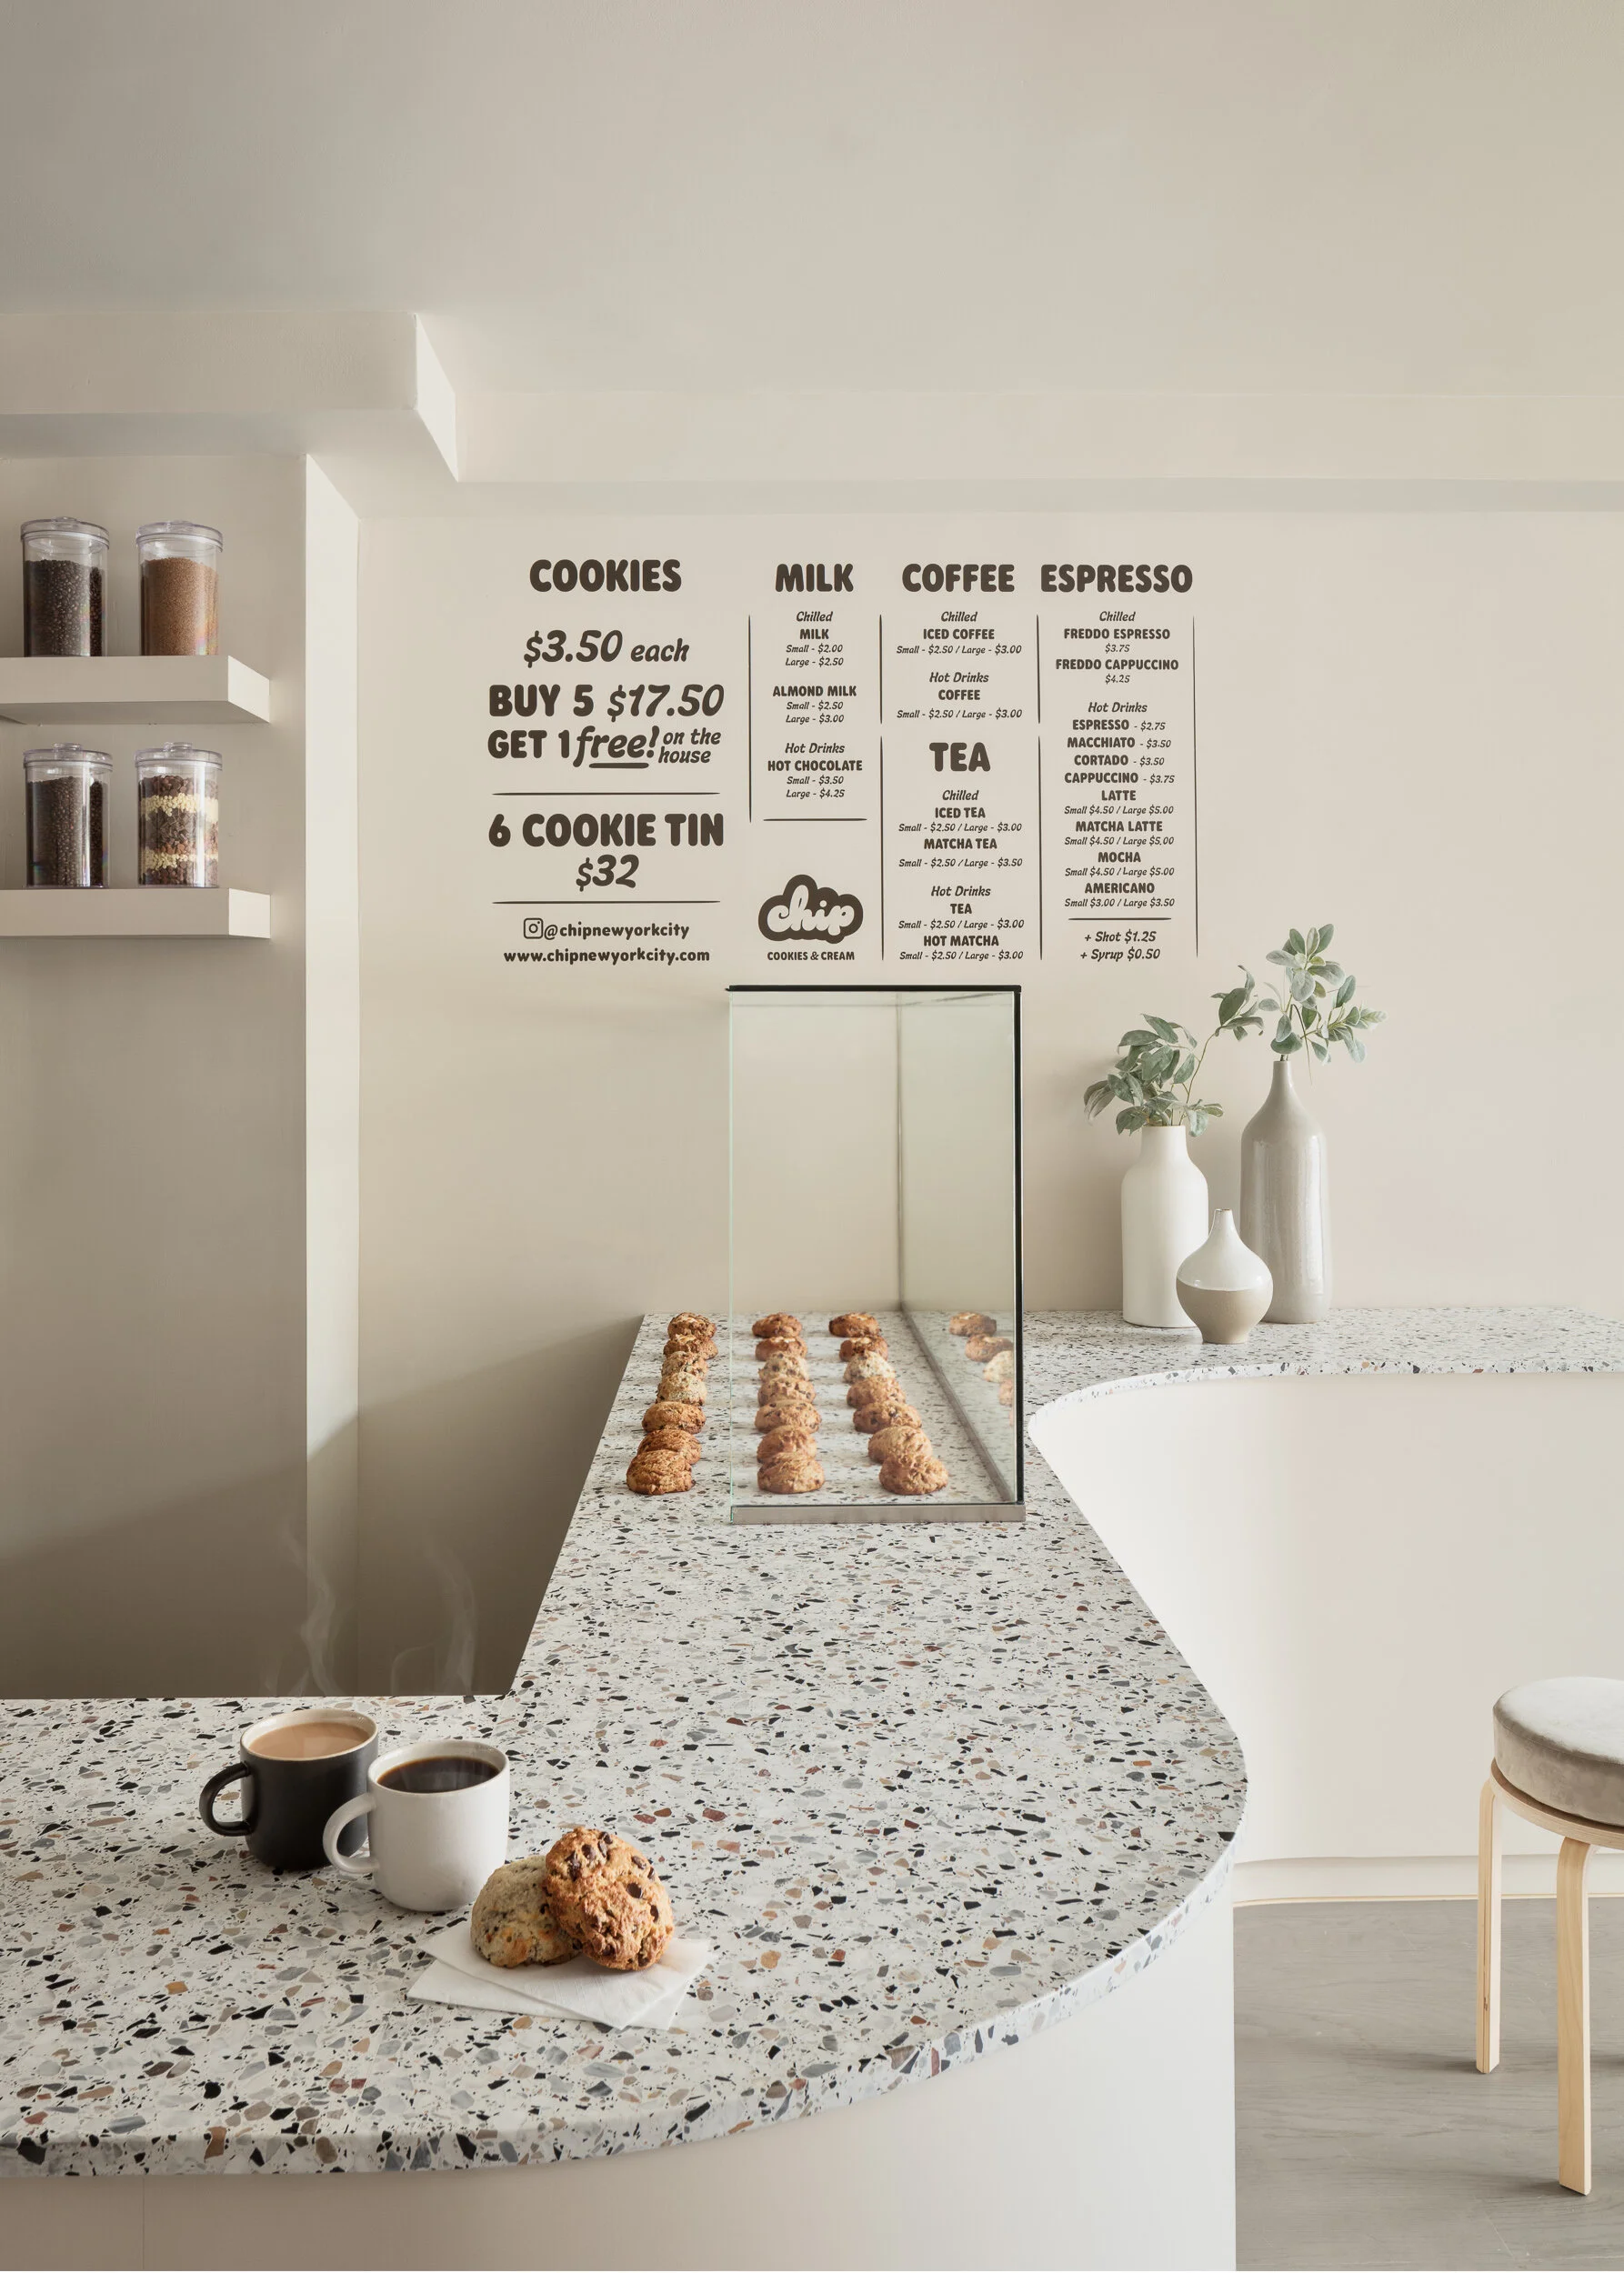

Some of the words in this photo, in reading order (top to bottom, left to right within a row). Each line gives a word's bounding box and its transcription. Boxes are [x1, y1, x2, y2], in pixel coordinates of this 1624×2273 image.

[529, 559, 682, 592] COOKIES
[775, 564, 854, 592] MILK
[902, 564, 1015, 592] COFFEE
[1041, 564, 1193, 593] ESPRESSO
[797, 611, 833, 622] Chilled
[941, 611, 978, 622] Chilled
[1099, 611, 1136, 622] Chilled
[799, 628, 829, 639] MILK
[923, 628, 949, 639] ICED
[953, 628, 995, 639] COFFEE
[1064, 628, 1109, 639] FREDDO
[1114, 628, 1170, 639] ESPRESSO
[524, 629, 623, 668] $3.50
[630, 637, 689, 662] each
[786, 645, 809, 653] Small
[817, 643, 843, 655] $2.00
[897, 646, 919, 654] Small
[928, 644, 953, 655] $2.50
[961, 646, 986, 656] Large
[995, 643, 1022, 656] $3.00
[1105, 643, 1130, 654] $3.75
[785, 657, 809, 668] Large
[818, 656, 844, 667] $2.50
[1056, 659, 1101, 670] FREDDO
[1105, 659, 1178, 670] CAPPUCCINO
[929, 672, 950, 683] Hot
[953, 672, 989, 683] Drinks
[1105, 673, 1130, 685] $4.25
[773, 686, 824, 696] ALMOND
[827, 686, 857, 696] MILK
[938, 689, 980, 700] COFFEE
[489, 684, 561, 717] BUY
[573, 685, 594, 716] 5
[607, 684, 724, 723] $17.50
[787, 701, 810, 710] Small
[818, 700, 844, 711] $2.50
[1088, 702, 1108, 713] Hot
[1111, 702, 1148, 713] Drinks
[786, 715, 810, 725] Large
[819, 713, 844, 725] $3.00
[897, 709, 920, 718] Small
[928, 707, 954, 720] $2.50
[962, 710, 986, 720] Large
[995, 707, 1022, 720] $3.00
[1073, 719, 1129, 730] ESPRESSO
[1140, 720, 1166, 732] $2.75
[487, 729, 547, 759] GET
[558, 729, 569, 758] 1
[573, 726, 660, 767] free!
[663, 732, 685, 745] on
[690, 727, 721, 745] the
[785, 743, 806, 754] Hot
[808, 743, 845, 754] Drinks
[1068, 736, 1135, 748] MACCHIATO
[1147, 738, 1171, 749] $3.50
[658, 746, 711, 764] house
[929, 742, 991, 772] TEA
[1074, 755, 1128, 766] CORTADO
[1139, 756, 1165, 767] $3.50
[767, 760, 791, 771] HOT
[795, 760, 863, 771] CHOCOLATE
[787, 776, 810, 785] Small
[818, 775, 844, 786] $3.50
[1064, 772, 1138, 784] CAPPUCCINO
[1149, 774, 1175, 785] $3.75
[786, 789, 810, 800] Large
[819, 787, 846, 799] $4.25
[942, 790, 979, 800] Chilled
[1101, 790, 1136, 801] LATTE
[935, 807, 961, 818] ICED
[963, 806, 986, 818] TEA
[1064, 806, 1088, 815] Small
[1089, 805, 1114, 816] $4.50
[1122, 806, 1147, 816] Large
[1148, 804, 1174, 816] $5.00
[488, 814, 511, 847] 6
[522, 813, 657, 847] COOKIE
[665, 813, 724, 846] TIN
[898, 823, 922, 832] Small
[930, 822, 956, 833] $2.50
[964, 823, 988, 834] Large
[997, 822, 1022, 833] $3.00
[1076, 821, 1124, 832] MATCHA
[1128, 821, 1163, 832] LATTE
[924, 838, 973, 849] MATCHA
[975, 838, 997, 849] TEA
[1064, 836, 1088, 845] Small
[1089, 835, 1115, 846] $4.50
[1123, 836, 1147, 847] Large
[1149, 835, 1174, 846] $5.00
[898, 858, 922, 867] Small
[930, 857, 956, 868] $2.50
[964, 858, 988, 869] Large
[997, 856, 1023, 868] $3.50
[1098, 852, 1141, 863] MOCHA
[576, 854, 639, 892] $32
[1065, 867, 1088, 876] Small
[1089, 866, 1115, 877] $4.50
[1123, 866, 1148, 877] Large
[1149, 866, 1175, 877] $5.00
[931, 886, 952, 896] Hot
[955, 886, 991, 896] Drinks
[1085, 883, 1155, 894] AMERICANO
[1065, 898, 1088, 906] Small
[1089, 897, 1116, 908] $3.00
[1123, 898, 1148, 909] Large
[1149, 896, 1175, 908] $3.50
[767, 884, 855, 936] chip
[949, 903, 972, 915] TEA
[898, 920, 922, 929] Small
[930, 918, 956, 930] $2.50
[964, 920, 987, 930] Large
[997, 917, 1025, 930] $3.00
[544, 921, 689, 940] @chipnewyorkcity
[1095, 931, 1121, 942] Shot
[1124, 928, 1157, 944] $1.25
[924, 936, 947, 946] HOT
[950, 936, 999, 946] MATCHA
[504, 947, 709, 966] www.chipnewyorkcity.com
[767, 951, 808, 960] COOKIES
[810, 951, 819, 960] &
[821, 951, 855, 960] CREAM
[899, 951, 923, 960] Small
[931, 949, 957, 961] $2.50
[965, 951, 989, 962] Large
[998, 949, 1024, 961] $3.00
[1091, 948, 1124, 962] Syrup
[1128, 946, 1160, 962] $0.50
